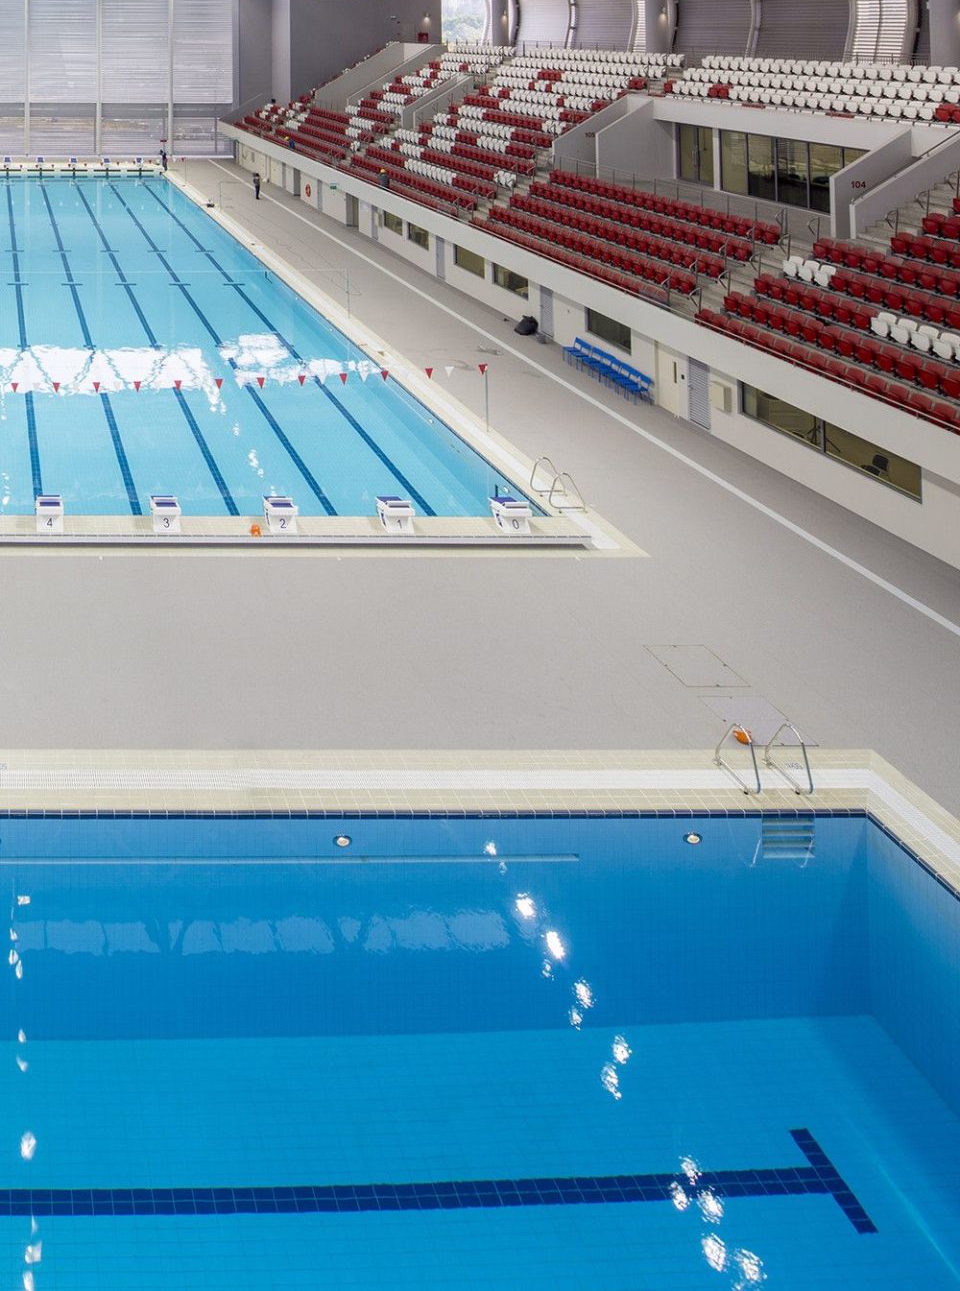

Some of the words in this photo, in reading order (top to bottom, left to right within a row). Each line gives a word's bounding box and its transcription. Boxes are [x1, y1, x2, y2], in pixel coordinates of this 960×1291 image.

[851, 180, 866, 189] 104
[47, 518, 53, 527] 4
[163, 518, 170, 528] 3
[280, 518, 286, 529] 2
[397, 519, 402, 529] 1
[512, 519, 520, 530] 0
